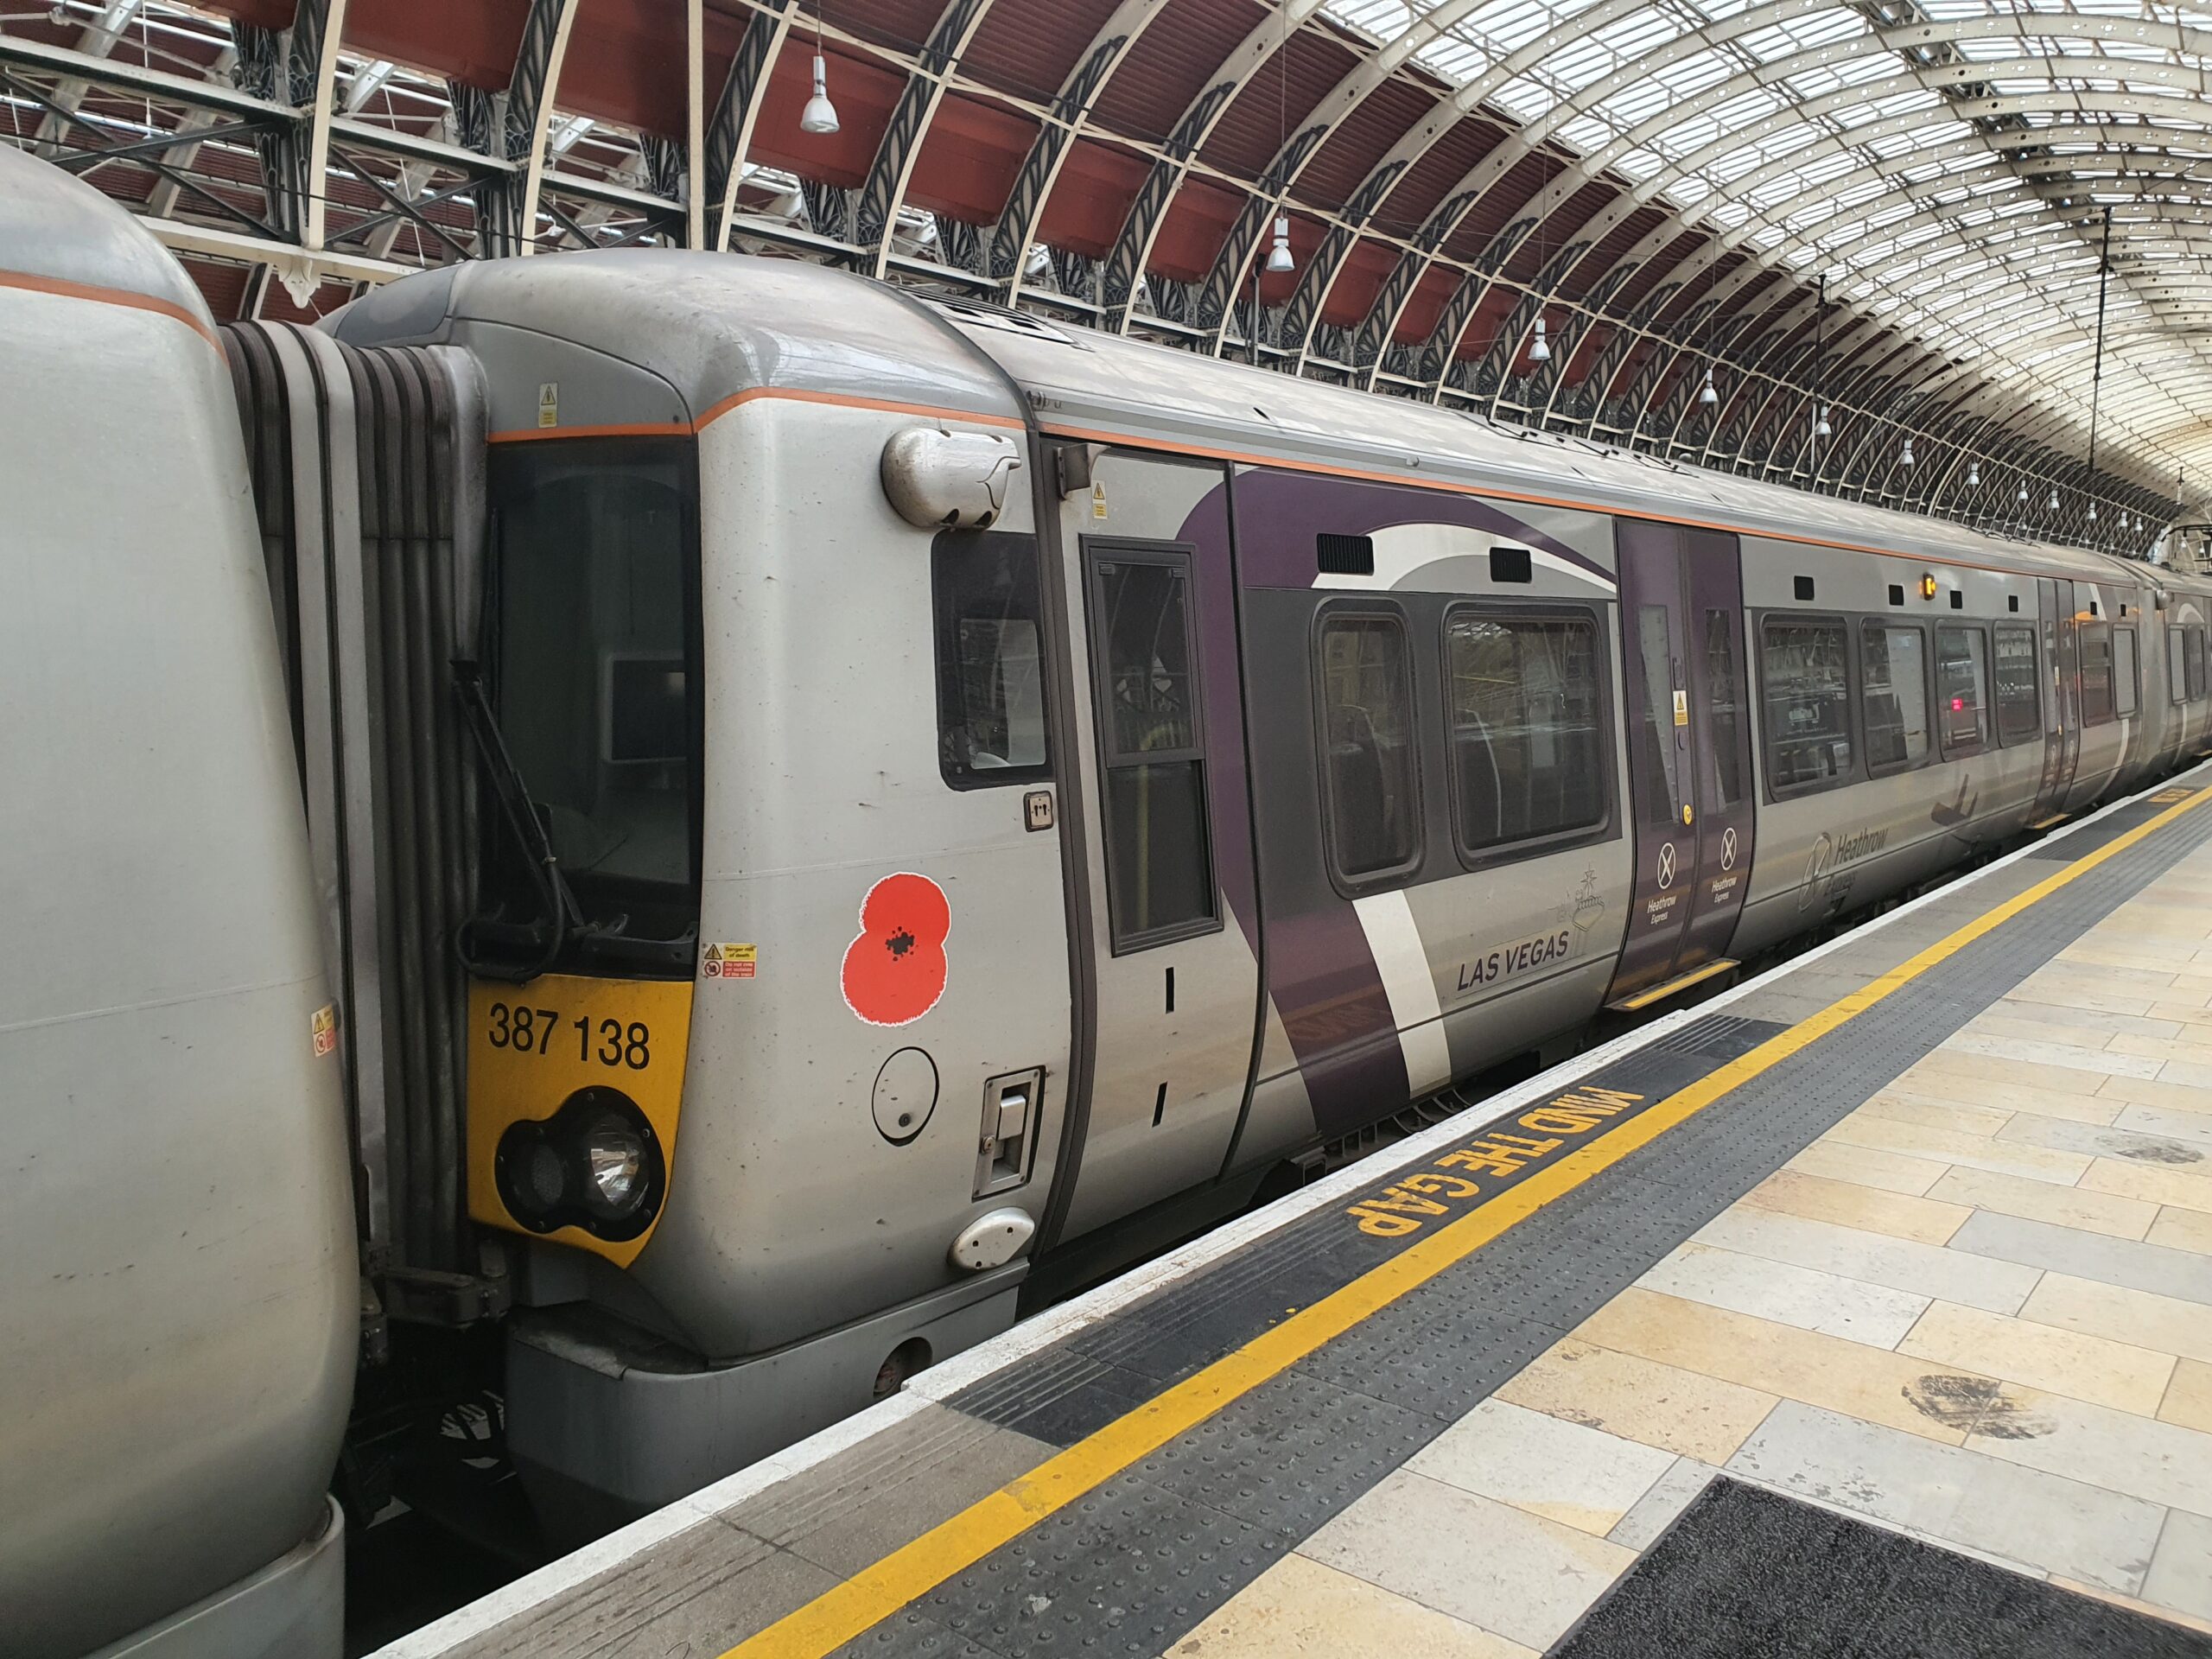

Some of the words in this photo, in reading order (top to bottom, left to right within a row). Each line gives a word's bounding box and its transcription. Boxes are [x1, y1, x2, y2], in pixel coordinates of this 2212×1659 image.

[1834, 827, 1889, 865] Heathrow
[1647, 894, 1676, 913] Heathrow
[1712, 876, 1737, 893] Heathrow
[1714, 892, 1729, 904] Express
[1650, 911, 1669, 925] Express
[1457, 952, 1500, 991] LAS
[1505, 931, 1569, 974] VEGAS
[488, 1002, 559, 1055] 387
[574, 1015, 650, 1070] 138
[1517, 1086, 1645, 1134] MIND
[1433, 1133, 1565, 1177] THE
[1346, 1173, 1480, 1236] GAP
